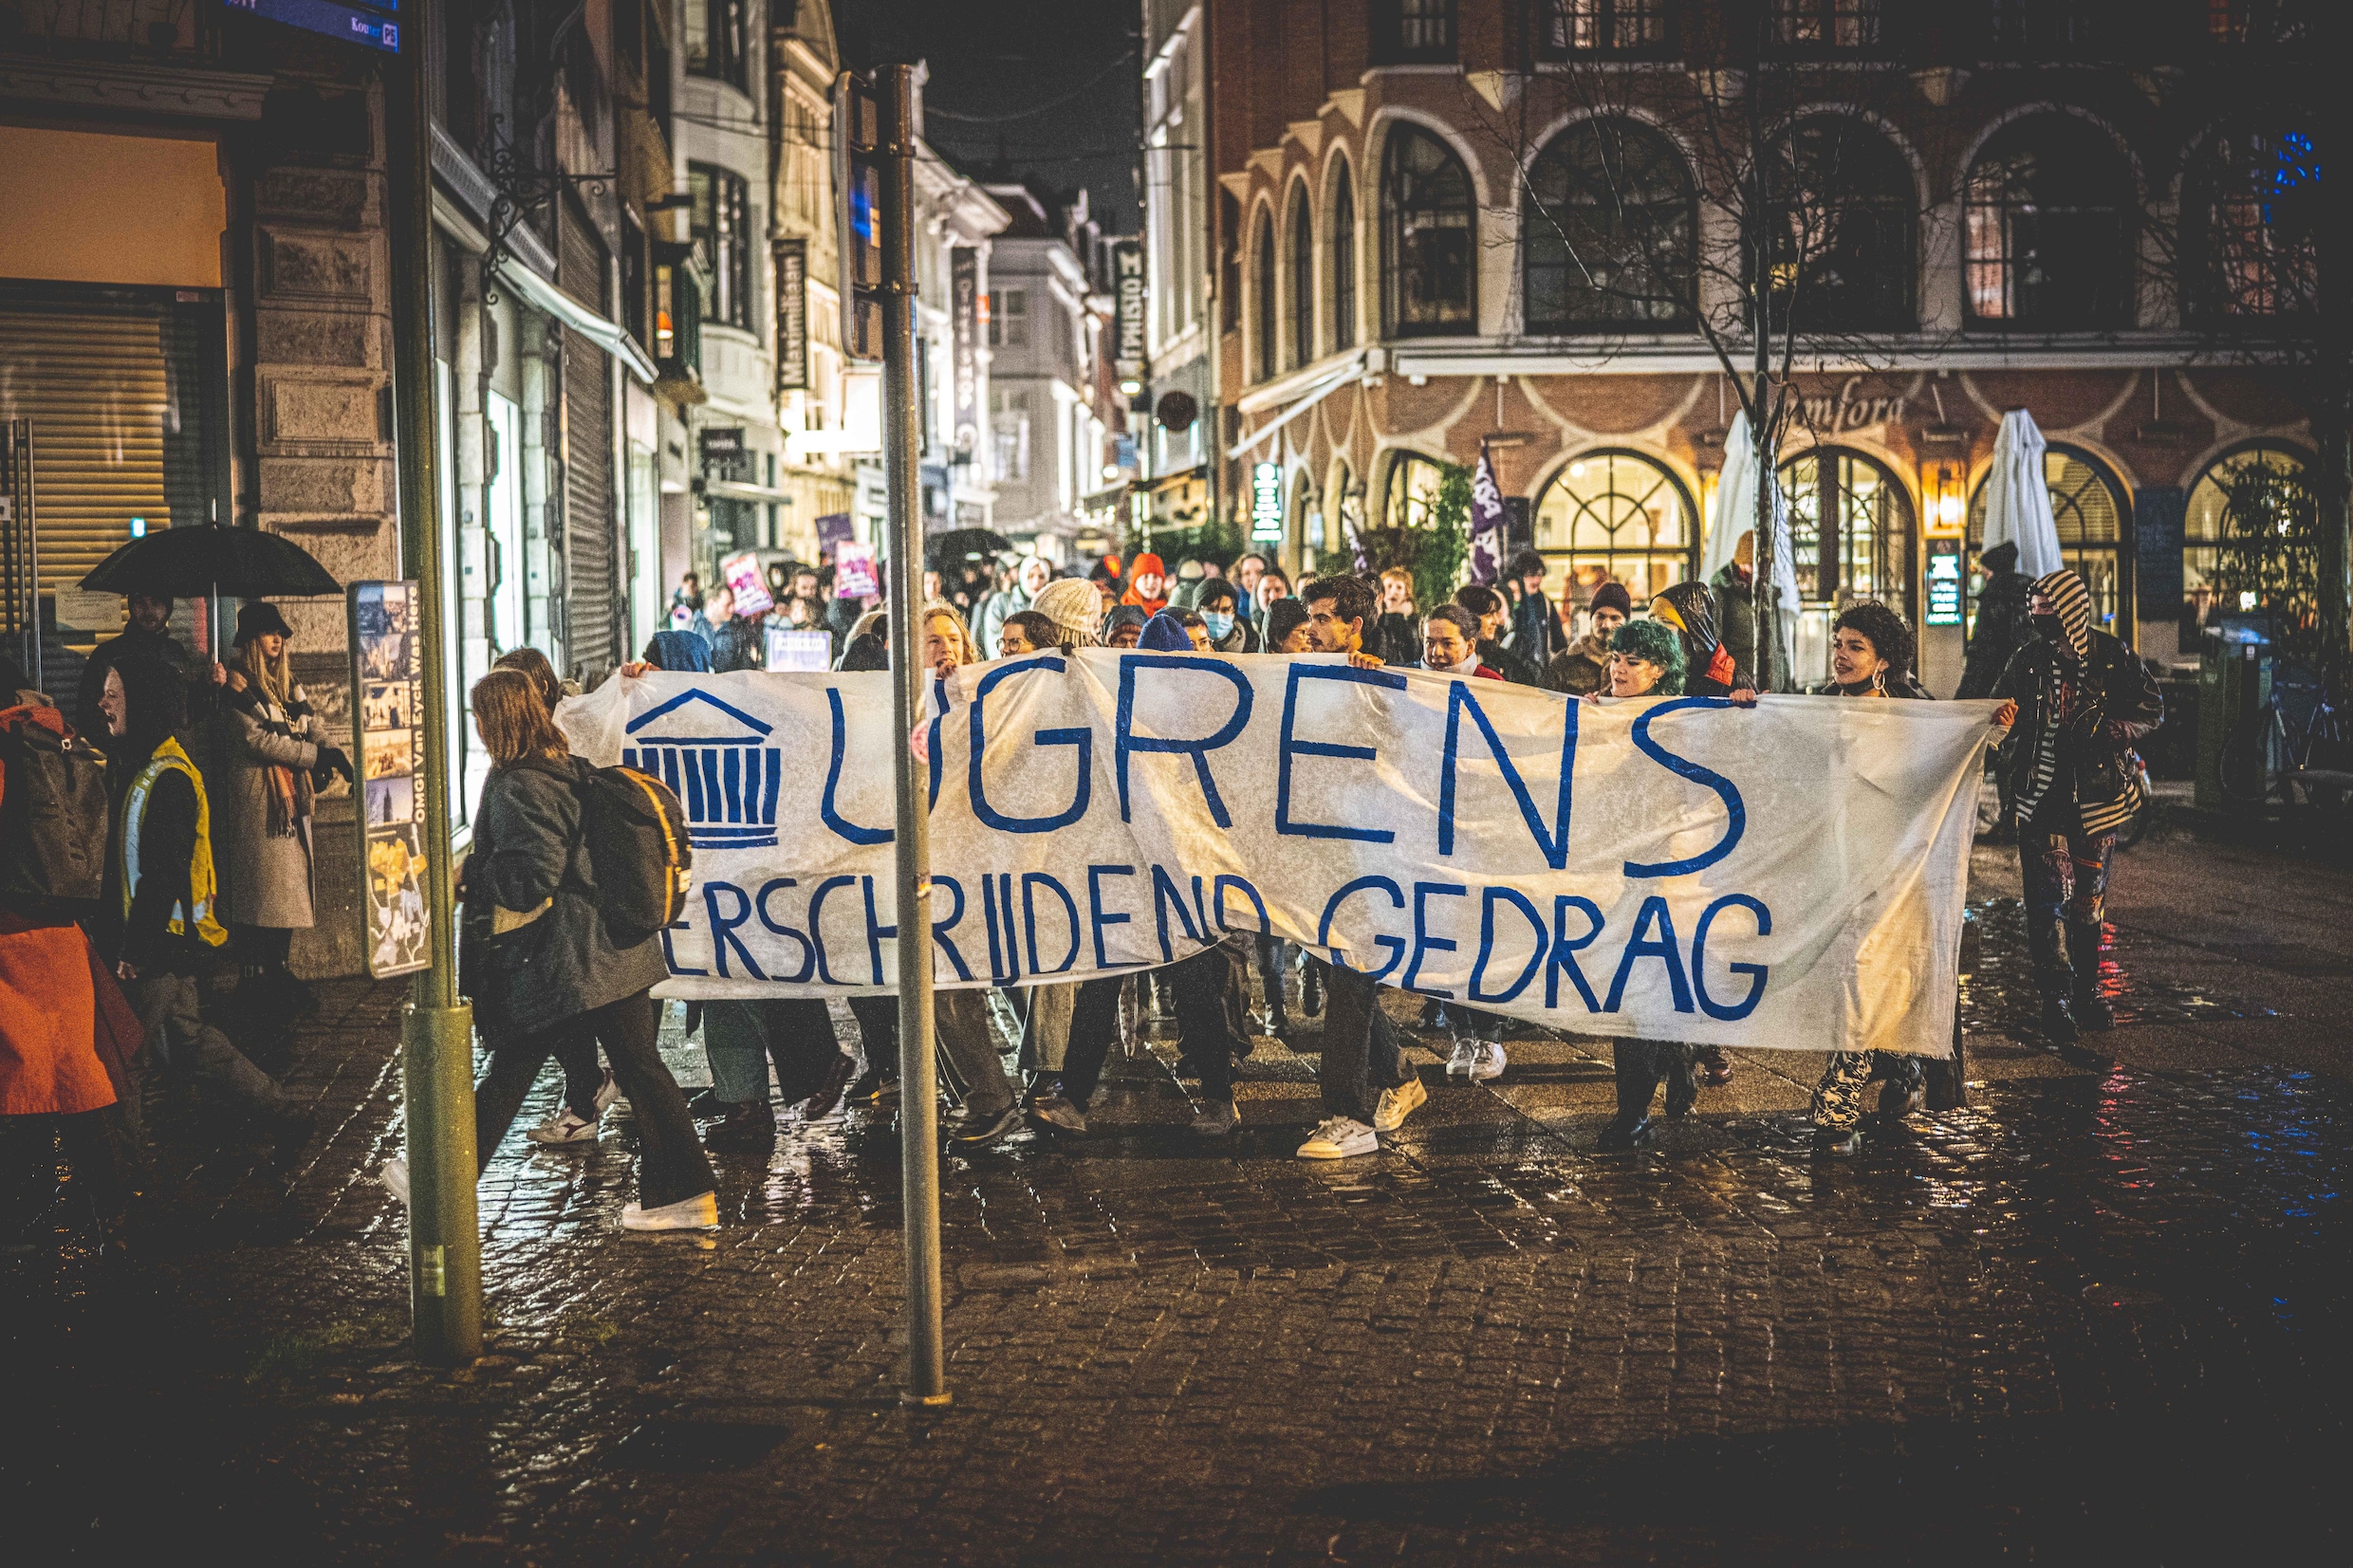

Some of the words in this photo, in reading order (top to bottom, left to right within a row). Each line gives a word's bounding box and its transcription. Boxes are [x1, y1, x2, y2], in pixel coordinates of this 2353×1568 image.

[351, 16, 380, 37] Kouter
[780, 254, 805, 385] Maximiliaan
[408, 585, 419, 631] Here
[409, 635, 421, 675] Was
[411, 679, 425, 726] Eyck
[413, 729, 424, 767] Van
[413, 772, 426, 823] OMG!
[661, 864, 1271, 987] ERSCHRIJDEND
[1317, 875, 1772, 1022] GEDRAG
